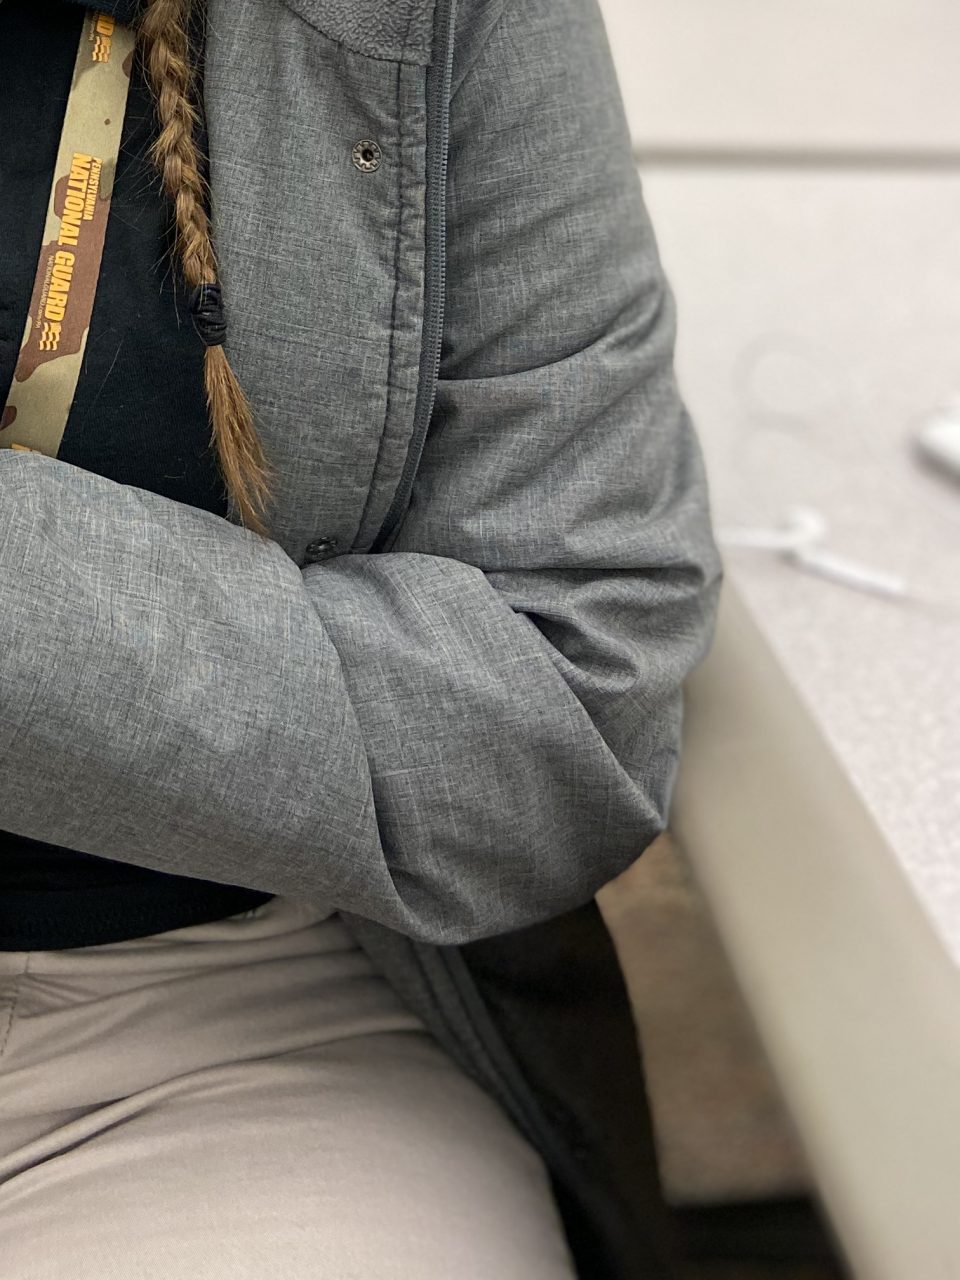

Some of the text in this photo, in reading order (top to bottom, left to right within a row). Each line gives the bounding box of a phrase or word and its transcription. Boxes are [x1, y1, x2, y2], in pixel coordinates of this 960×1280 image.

[45, 152, 92, 321] NATIONAL GUARD
[82, 156, 103, 220] PENNSYLVANIA
